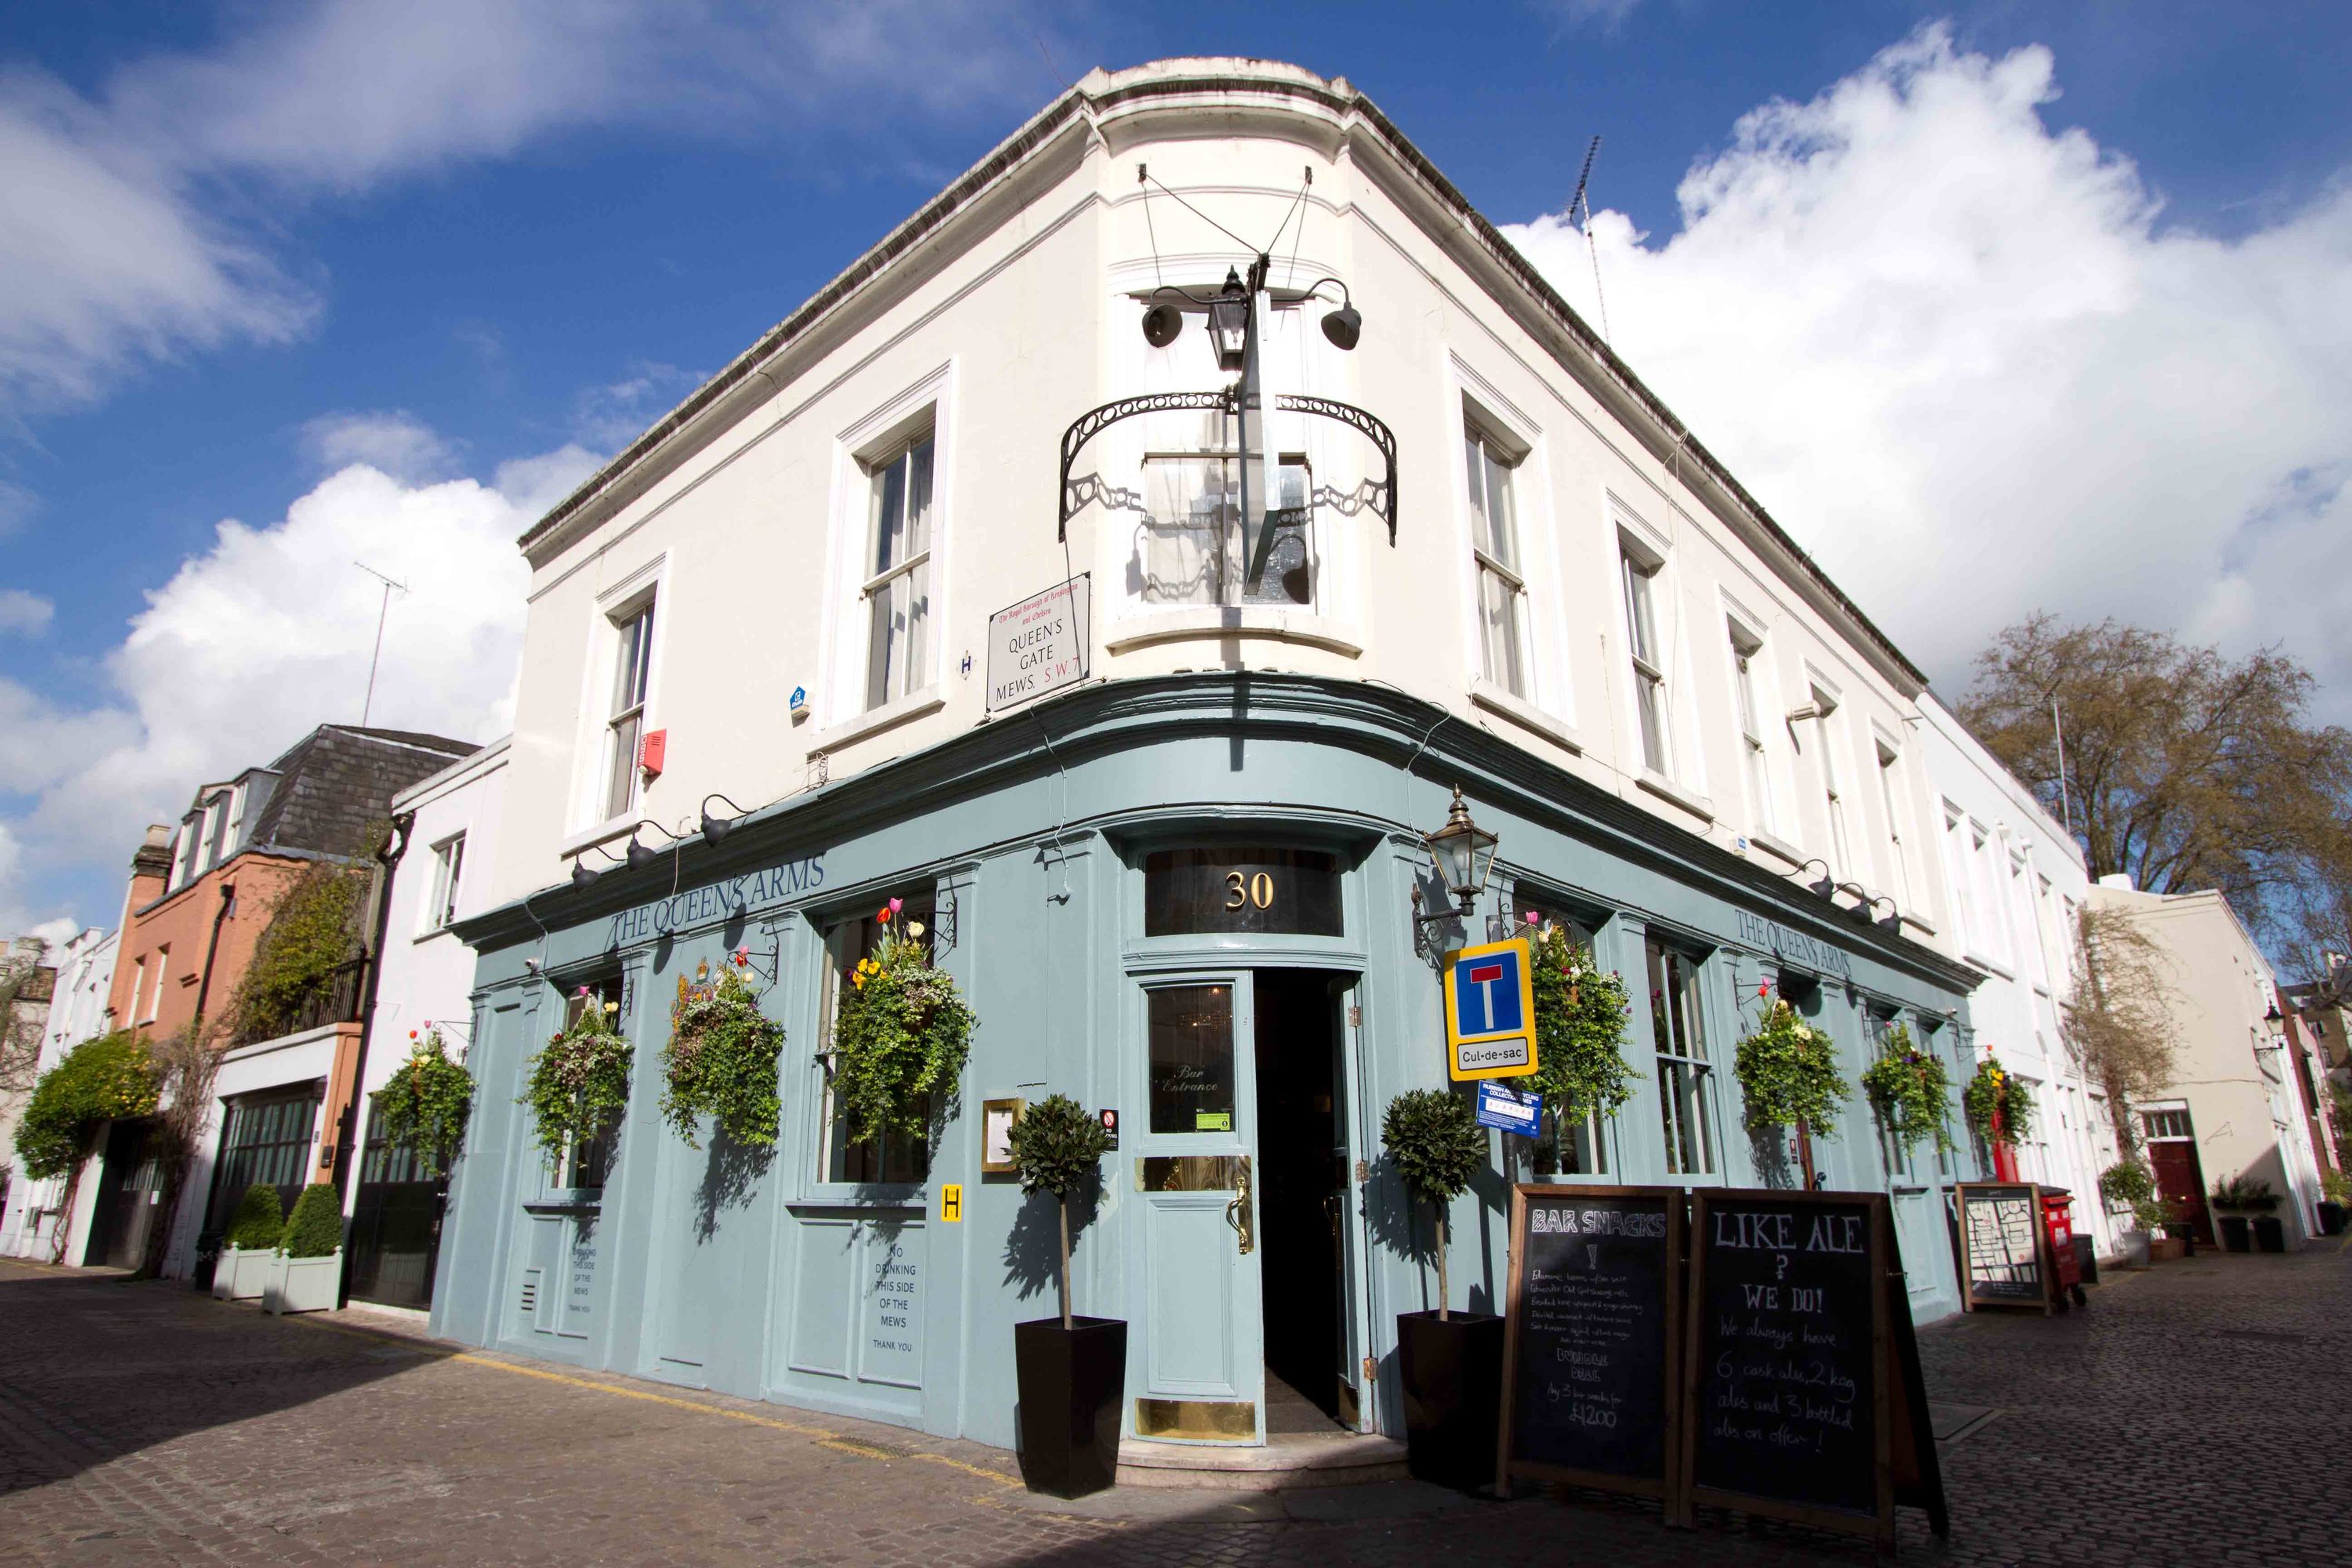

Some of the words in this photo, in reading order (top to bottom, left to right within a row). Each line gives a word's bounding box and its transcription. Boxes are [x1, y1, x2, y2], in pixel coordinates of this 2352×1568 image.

[999, 615, 1007, 624] The
[1008, 606, 1022, 619] Royal
[1023, 598, 1043, 614] Borough
[1044, 594, 1050, 603] of
[1051, 583, 1079, 601] Kensingon
[1022, 615, 1031, 625] and
[1032, 608, 1051, 621] Chelsea
[1009, 619, 1062, 654] QUEEN'S
[961, 655, 971, 674] H
[1020, 644, 1054, 670] GATE
[612, 905, 650, 944] THE
[749, 853, 826, 905] ARMS
[1225, 871, 1274, 911] 30
[1735, 909, 1766, 946] THE
[1821, 942, 1852, 978] ARMS
[1462, 1048, 1523, 1062] Cul-de-sac
[1174, 1065, 1204, 1079] Bar
[1163, 1078, 1218, 1092] Entrance
[1483, 1083, 1504, 1094] RUBBISH
[944, 1189, 959, 1218] H
[1531, 1209, 1579, 1233] BAR
[1582, 1210, 1667, 1238] SNACKS
[1712, 1210, 1797, 1251] LIKE
[1805, 1211, 1865, 1255] ALE
[890, 1243, 903, 1258] NO
[875, 1264, 916, 1276] DRINKING
[1774, 1253, 1790, 1281] ?
[574, 1287, 589, 1295] MEWS
[876, 1281, 895, 1292] THIS
[896, 1281, 915, 1293] SIDE
[1740, 1283, 1780, 1311] WE
[1791, 1287, 1824, 1314] DO!
[879, 1298, 891, 1309] OF
[892, 1299, 909, 1310] THE
[880, 1316, 907, 1328] MEWS
[1719, 1313, 1739, 1338] We
[1744, 1316, 1795, 1350] always
[1803, 1322, 1838, 1348] have
[873, 1339, 895, 1350] THANK
[898, 1341, 913, 1352] YOU
[1715, 1349, 1733, 1379] 6
[1743, 1362, 1776, 1381] cask
[1809, 1360, 1827, 1386] 2
[1830, 1367, 1857, 1403] keg
[1562, 1383, 1571, 1398] 3
[1717, 1384, 1749, 1410] ales
[1753, 1393, 1780, 1415] and
[1784, 1394, 1802, 1418] 3
[1806, 1396, 1857, 1432] bottled
[1713, 1416, 1740, 1439] ales
[1744, 1428, 1763, 1441] on
